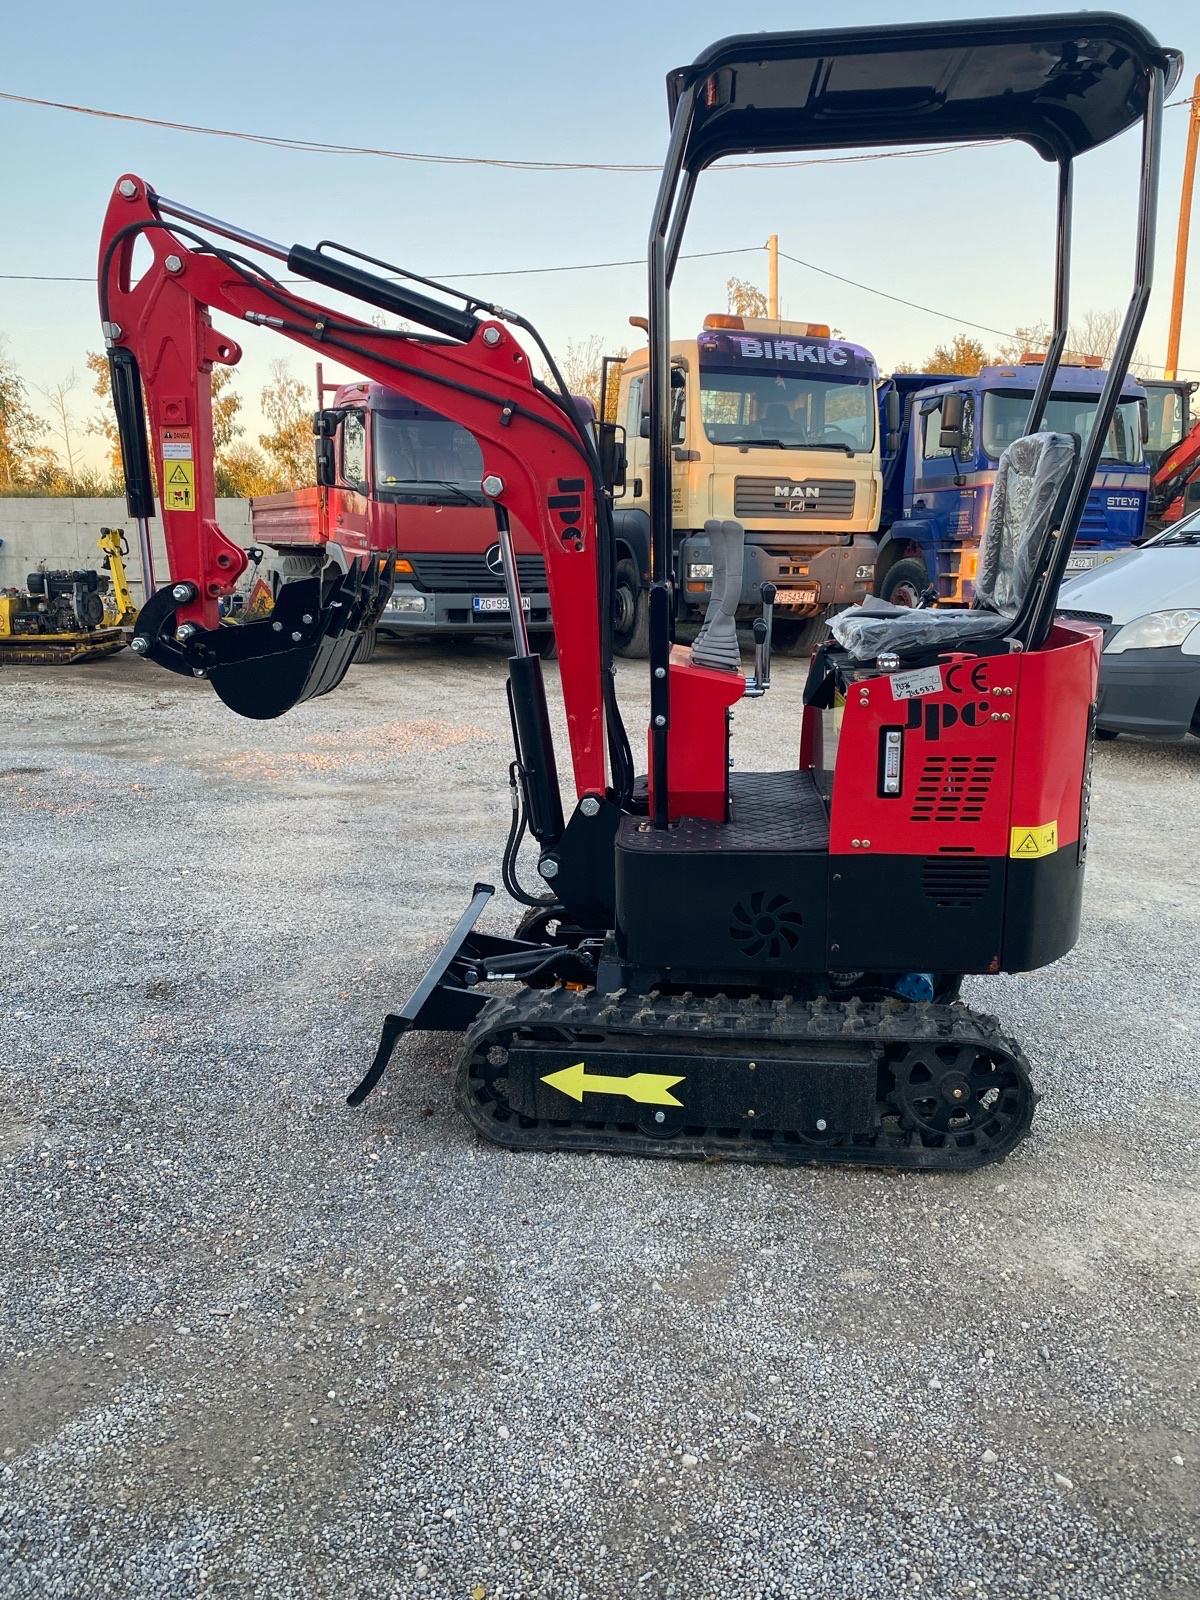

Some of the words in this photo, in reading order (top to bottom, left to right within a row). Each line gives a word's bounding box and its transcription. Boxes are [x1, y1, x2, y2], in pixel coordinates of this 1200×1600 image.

[774, 486, 820, 498] MAN
[1106, 496, 1140, 506] STEYR
[480, 599, 491, 609] ZG
[945, 662, 988, 693] CE
